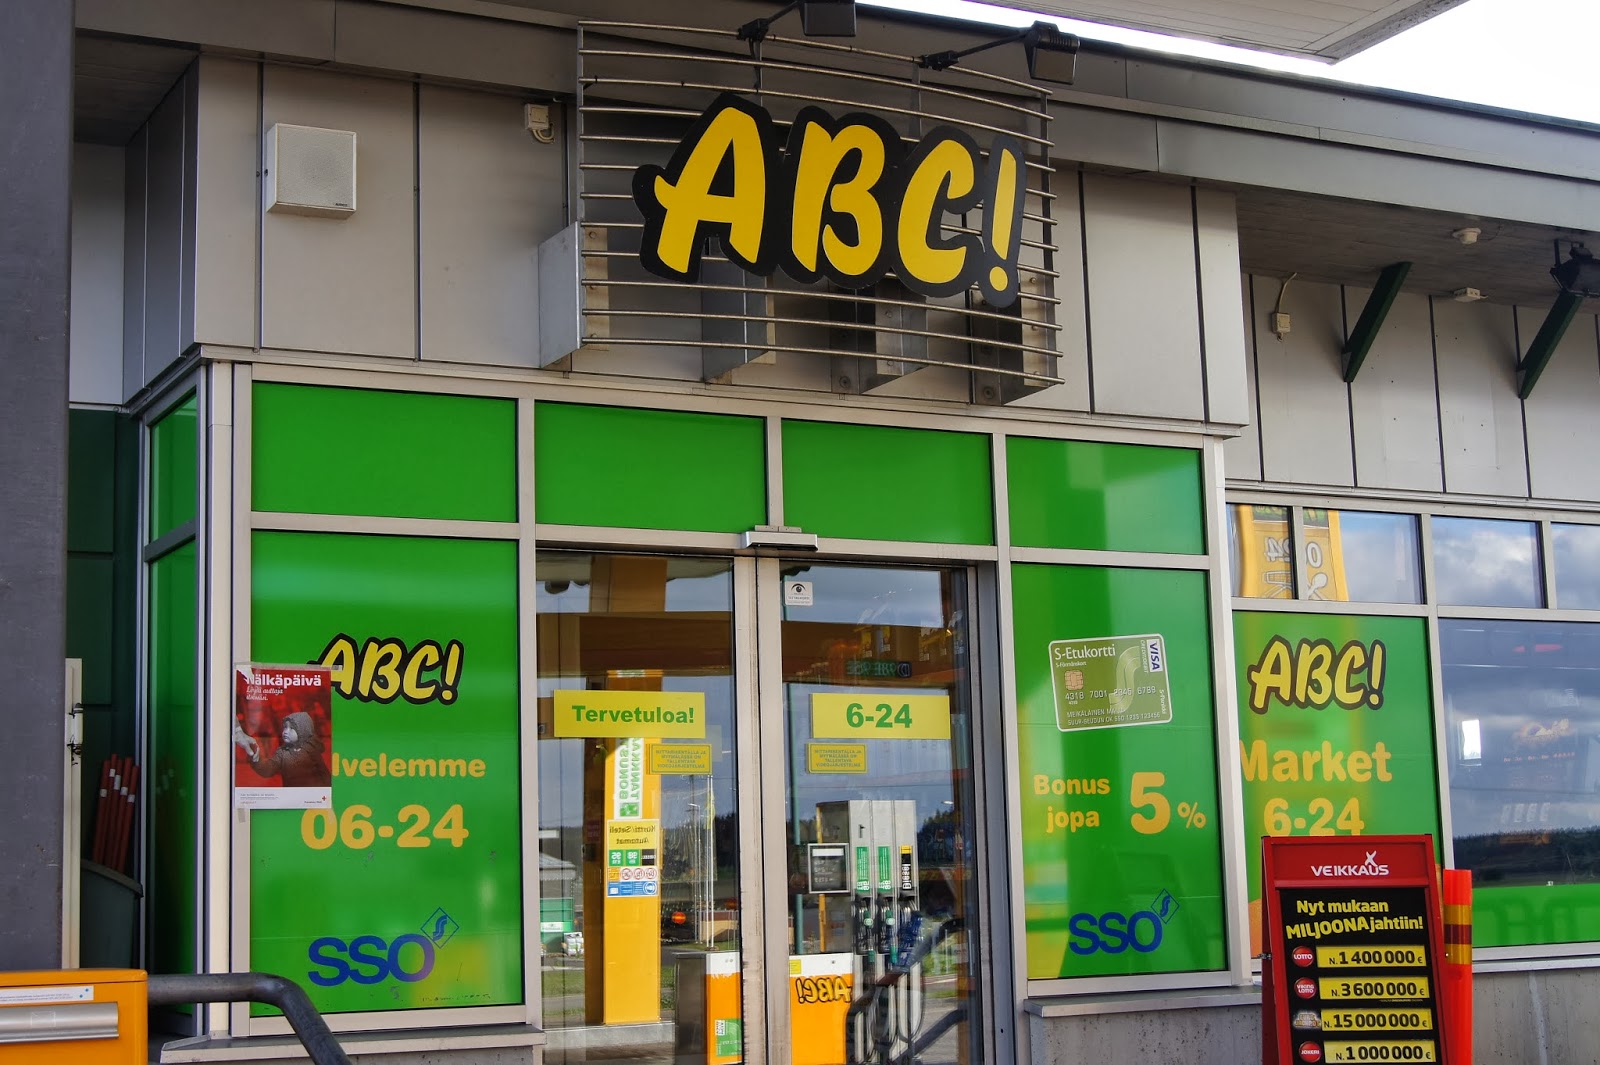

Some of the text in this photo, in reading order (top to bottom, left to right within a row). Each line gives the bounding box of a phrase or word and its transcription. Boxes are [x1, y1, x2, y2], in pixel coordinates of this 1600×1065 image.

[632, 93, 1028, 308] ABC!
[1054, 643, 1116, 660] S-Etukortti
[1149, 642, 1160, 670] VISA
[306, 632, 464, 704] ABC!
[1247, 634, 1386, 714] ABC!
[1065, 692, 1085, 701] 4318
[1089, 690, 1108, 699] 7001
[1137, 686, 1156, 695] 6789
[571, 705, 694, 723] Tervetuloa!
[845, 702, 913, 728] 6-24
[331, 752, 486, 777] lvelemme
[1239, 739, 1393, 782] Market
[1033, 774, 1111, 796] Bonus
[1130, 771, 1207, 834] 5 %
[1264, 797, 1365, 836] 6-24
[301, 804, 469, 849] 06-24
[1046, 805, 1100, 833] jopa
[1310, 863, 1389, 876] VEIKKAUS
[1296, 900, 1389, 916] Nyt mukaan
[1068, 911, 1163, 955] SSO
[308, 932, 436, 986] SSO
